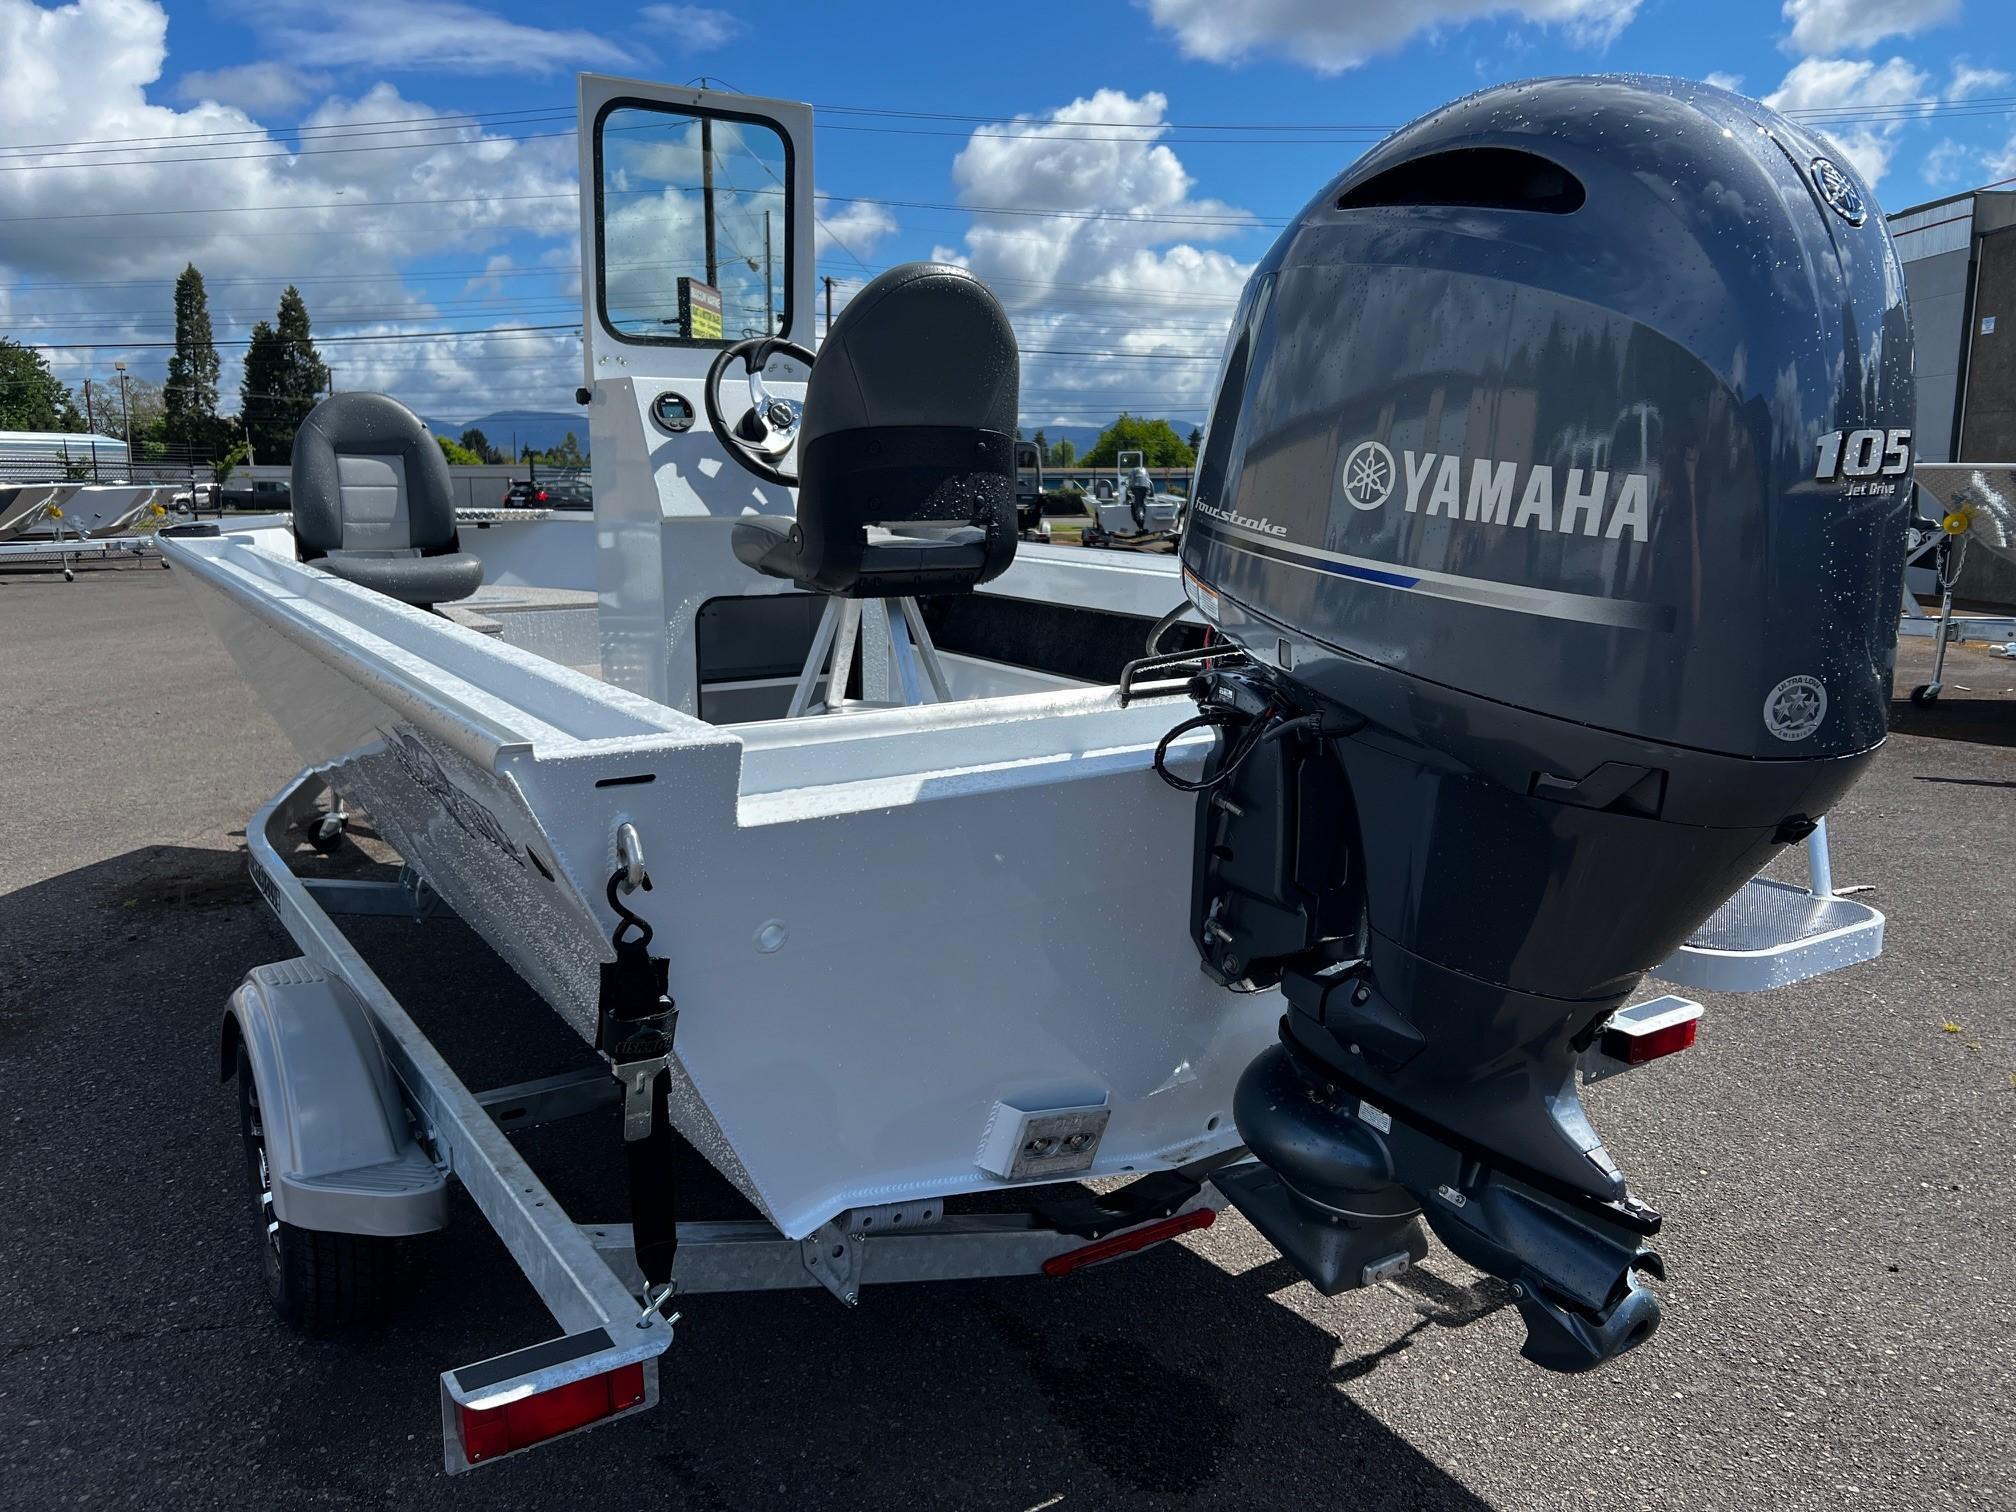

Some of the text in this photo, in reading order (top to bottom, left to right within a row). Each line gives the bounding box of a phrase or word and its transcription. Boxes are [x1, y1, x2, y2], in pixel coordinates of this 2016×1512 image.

[1815, 429, 1912, 478] 105
[1403, 450, 1649, 542] YAMAHA
[1845, 481, 1896, 496] Jet Drive
